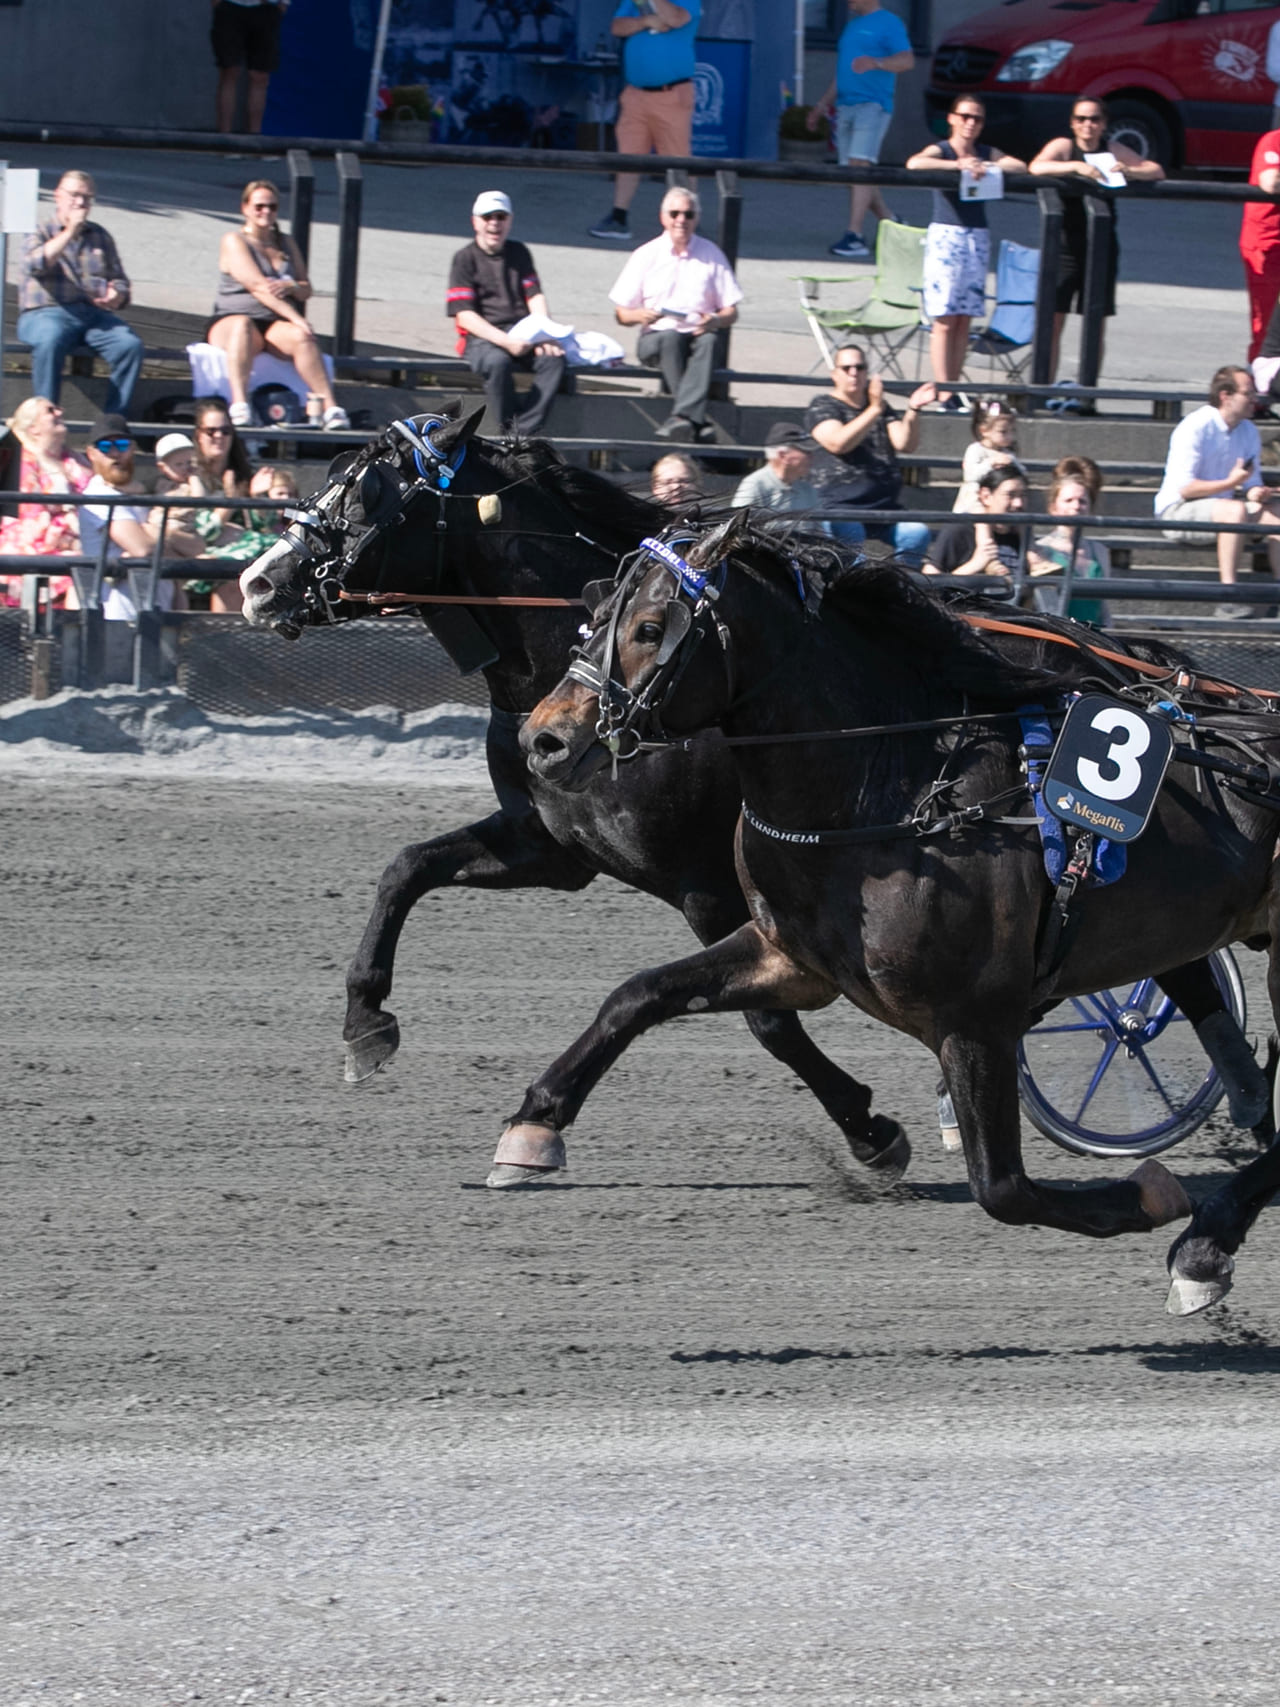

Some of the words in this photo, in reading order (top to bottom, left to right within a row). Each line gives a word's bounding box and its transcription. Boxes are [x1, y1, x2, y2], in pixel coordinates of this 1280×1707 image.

[1077, 707, 1151, 801] 3
[751, 816, 820, 844] LUNDHEIM
[1072, 801, 1126, 833] Megaflis
